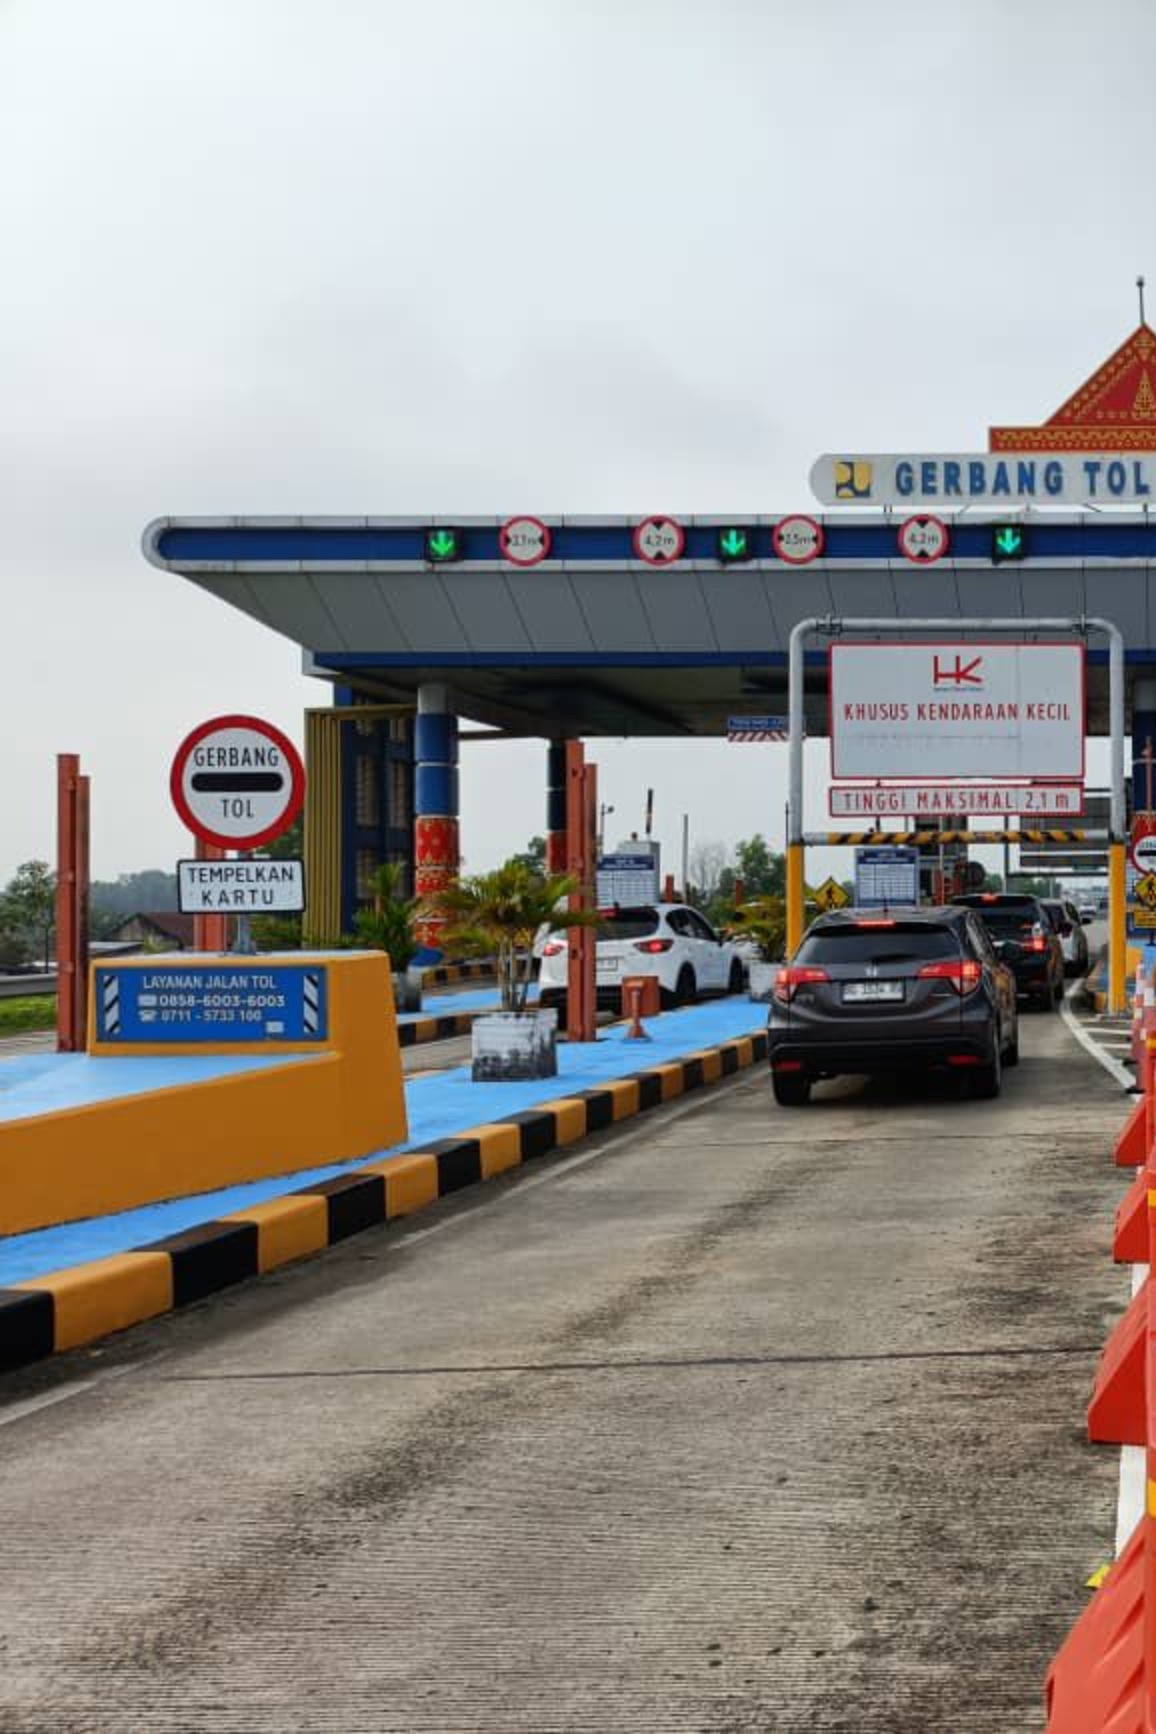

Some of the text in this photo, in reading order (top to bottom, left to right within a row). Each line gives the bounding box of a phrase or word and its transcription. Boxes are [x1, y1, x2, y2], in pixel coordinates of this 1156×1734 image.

[895, 460, 1064, 496] GERBANG
[1083, 461, 1149, 496] TOL
[844, 703, 1071, 721] KHUSUS KENDARAAN KECIL
[193, 747, 279, 767] GERBANG
[220, 799, 255, 818] TOL
[844, 793, 906, 811] TINGGI
[917, 792, 1015, 811] MAKSIMAL
[188, 867, 294, 884] TEMPELKAN
[201, 890, 274, 907] KARTU
[143, 976, 277, 989] LAYANAN JALAN TOL
